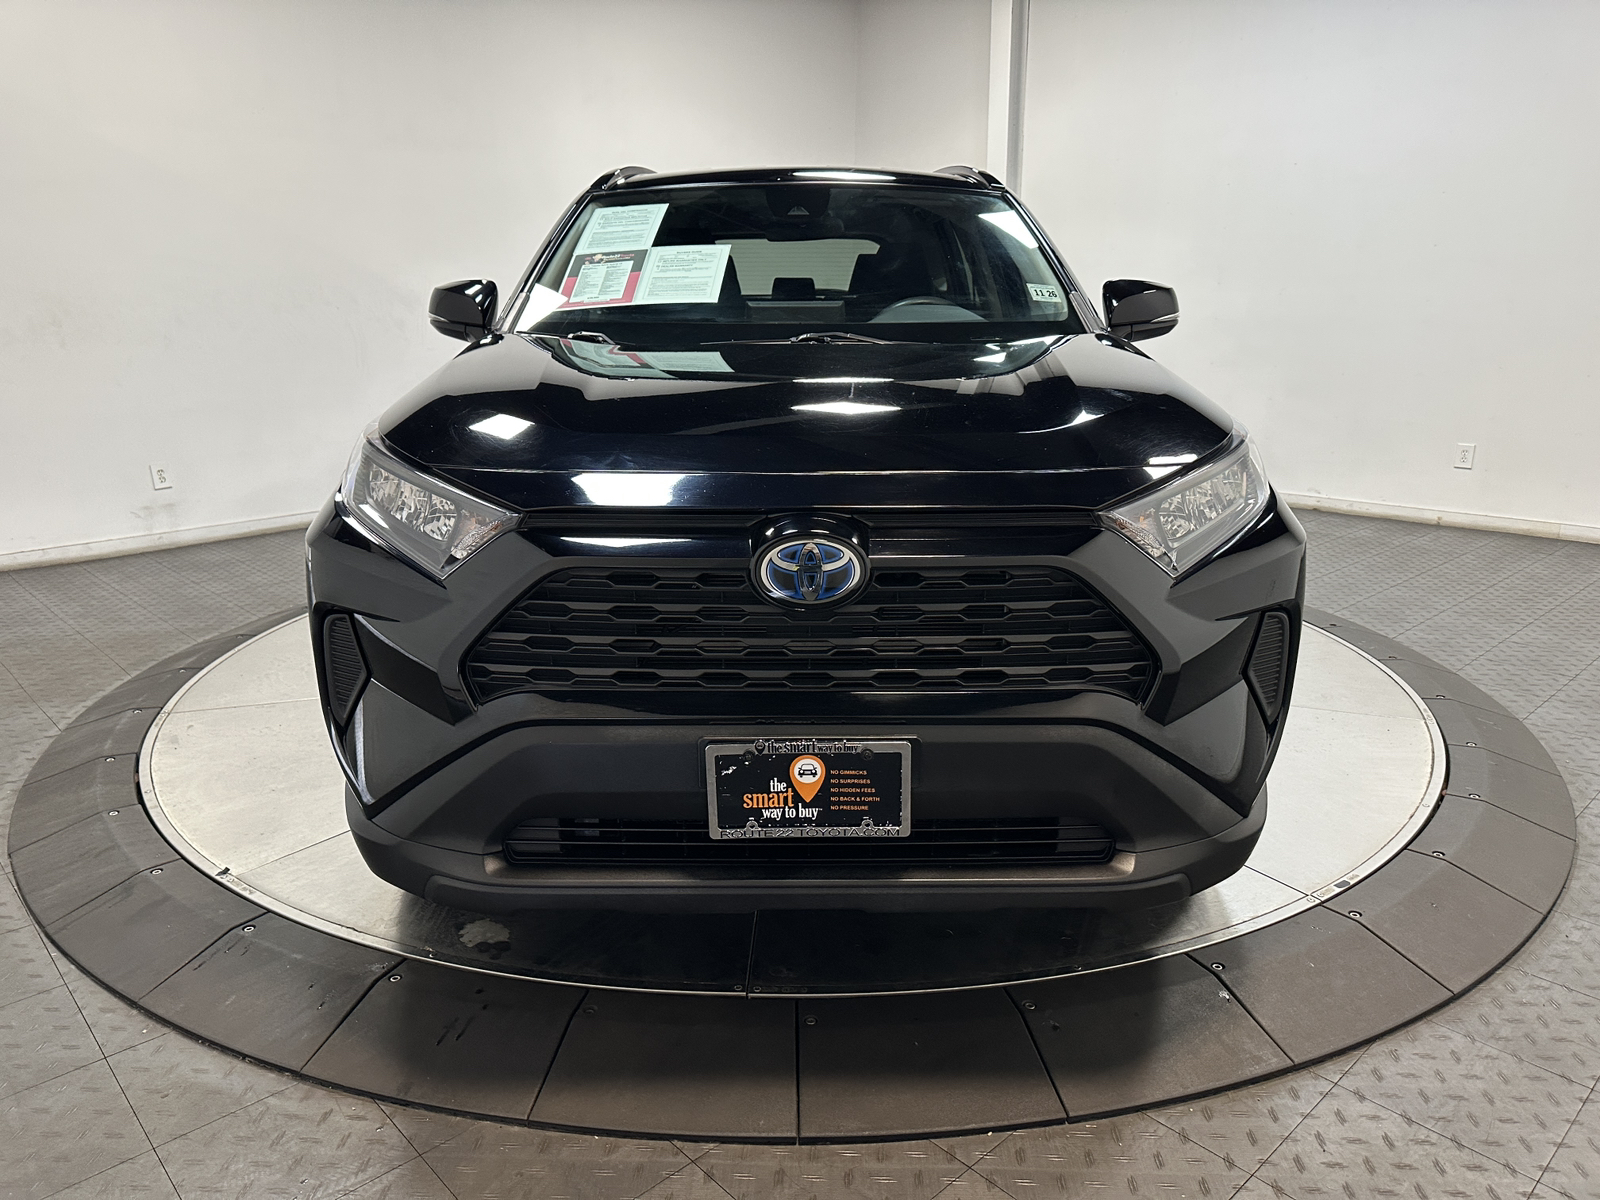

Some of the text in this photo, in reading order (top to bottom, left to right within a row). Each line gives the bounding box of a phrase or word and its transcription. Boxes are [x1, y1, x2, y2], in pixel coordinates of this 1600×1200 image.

[1034, 289, 1057, 298] 11 26
[767, 740, 782, 754] the
[783, 740, 816, 754] smart
[817, 744, 833, 755] way
[833, 742, 842, 753] to
[769, 777, 787, 792] the
[743, 788, 794, 809] smart
[762, 802, 819, 821] way to buy
